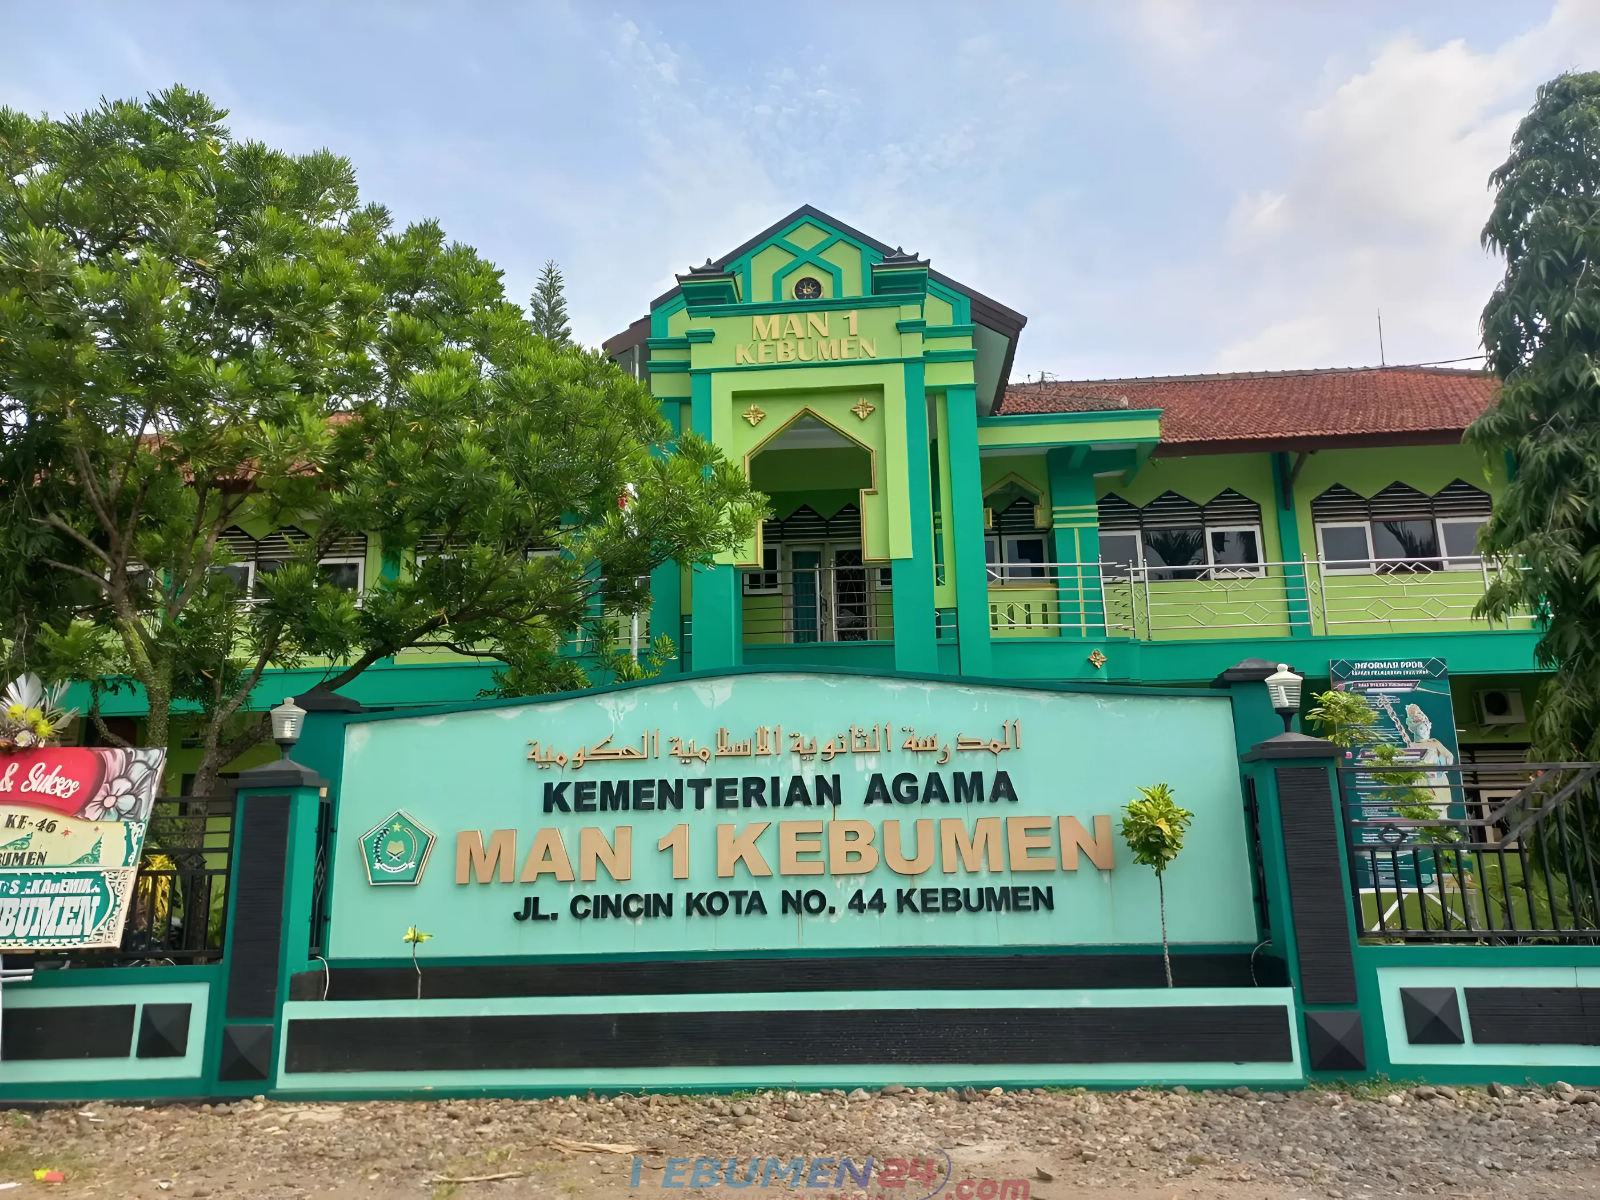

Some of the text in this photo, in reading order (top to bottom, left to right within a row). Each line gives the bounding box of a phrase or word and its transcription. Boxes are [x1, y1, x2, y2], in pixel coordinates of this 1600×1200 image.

[752, 309, 858, 341] MAN 1
[735, 337, 877, 365] KEBUMEN
[789, 721, 892, 762] الثانوية
[902, 718, 1021, 765] المدرسة
[543, 770, 1019, 813] KEMENTERIAN AGAMA
[4, 813, 59, 834] KE-46
[455, 815, 1115, 884] MAN 1 KEBUMEN
[0, 895, 101, 938] BUMEN
[513, 885, 1055, 921] JL. CINCIN KOTA NO. 44 KEBUMEN
